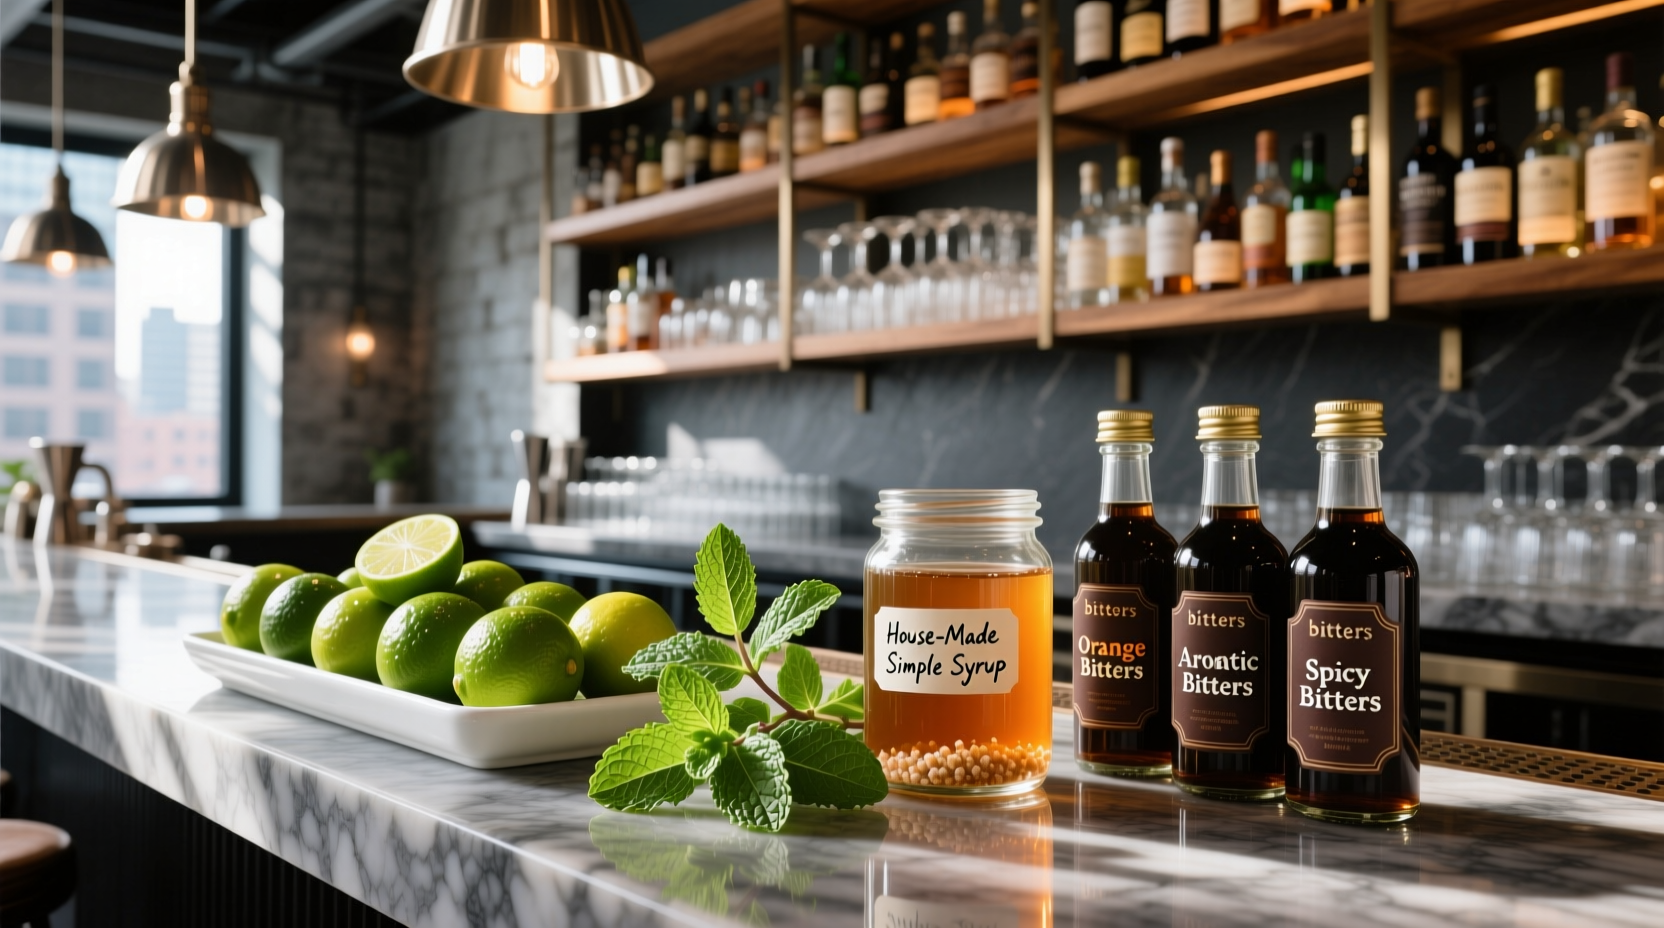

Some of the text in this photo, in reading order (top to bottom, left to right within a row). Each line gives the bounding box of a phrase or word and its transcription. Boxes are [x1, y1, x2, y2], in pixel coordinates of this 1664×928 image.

[1084, 599, 1137, 617] bitters
[1188, 609, 1245, 628] bitters
[887, 621, 999, 645] House-Made
[1309, 619, 1373, 640] bitters
[1078, 635, 1145, 662] Orange
[886, 651, 1006, 686] Simple Syrup
[1080, 657, 1143, 679] Bitters
[1305, 658, 1371, 689] Spicy
[1182, 671, 1253, 696] Bitters
[1299, 685, 1382, 712] Bitters
